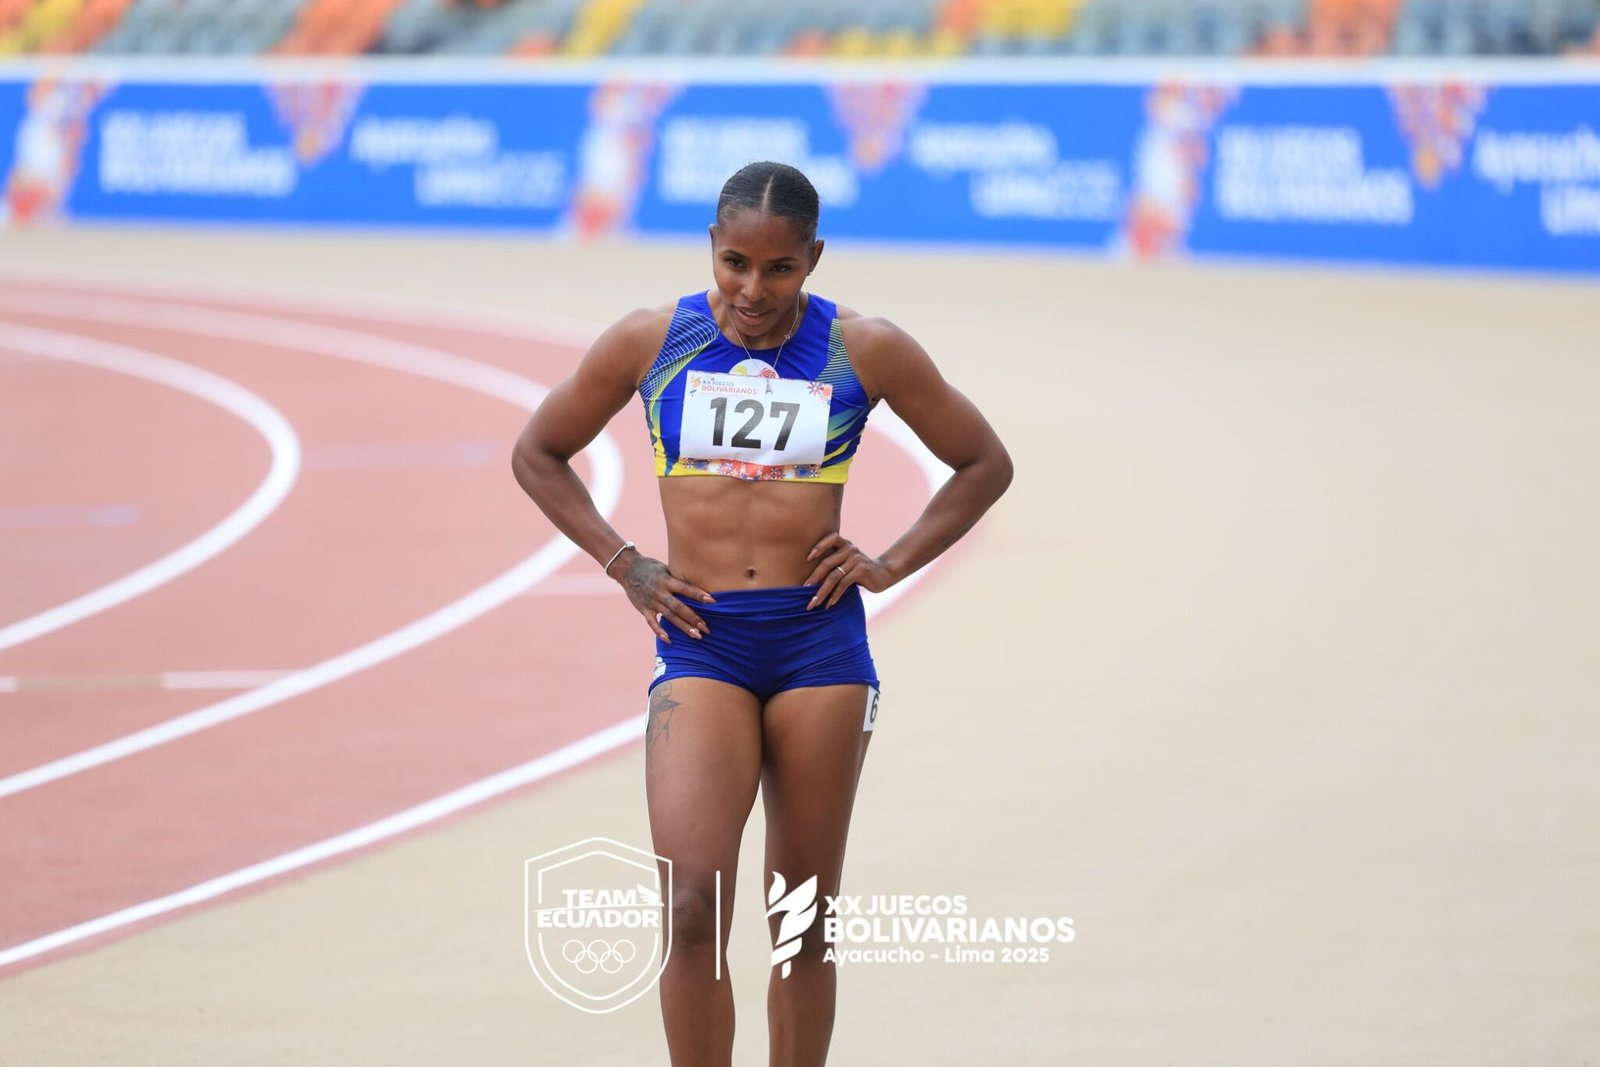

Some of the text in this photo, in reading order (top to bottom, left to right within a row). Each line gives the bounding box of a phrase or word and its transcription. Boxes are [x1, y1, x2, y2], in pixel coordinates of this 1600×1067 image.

[702, 385, 757, 395] BOLIVARIANOS
[710, 396, 800, 452] 127
[870, 692, 879, 723] 6
